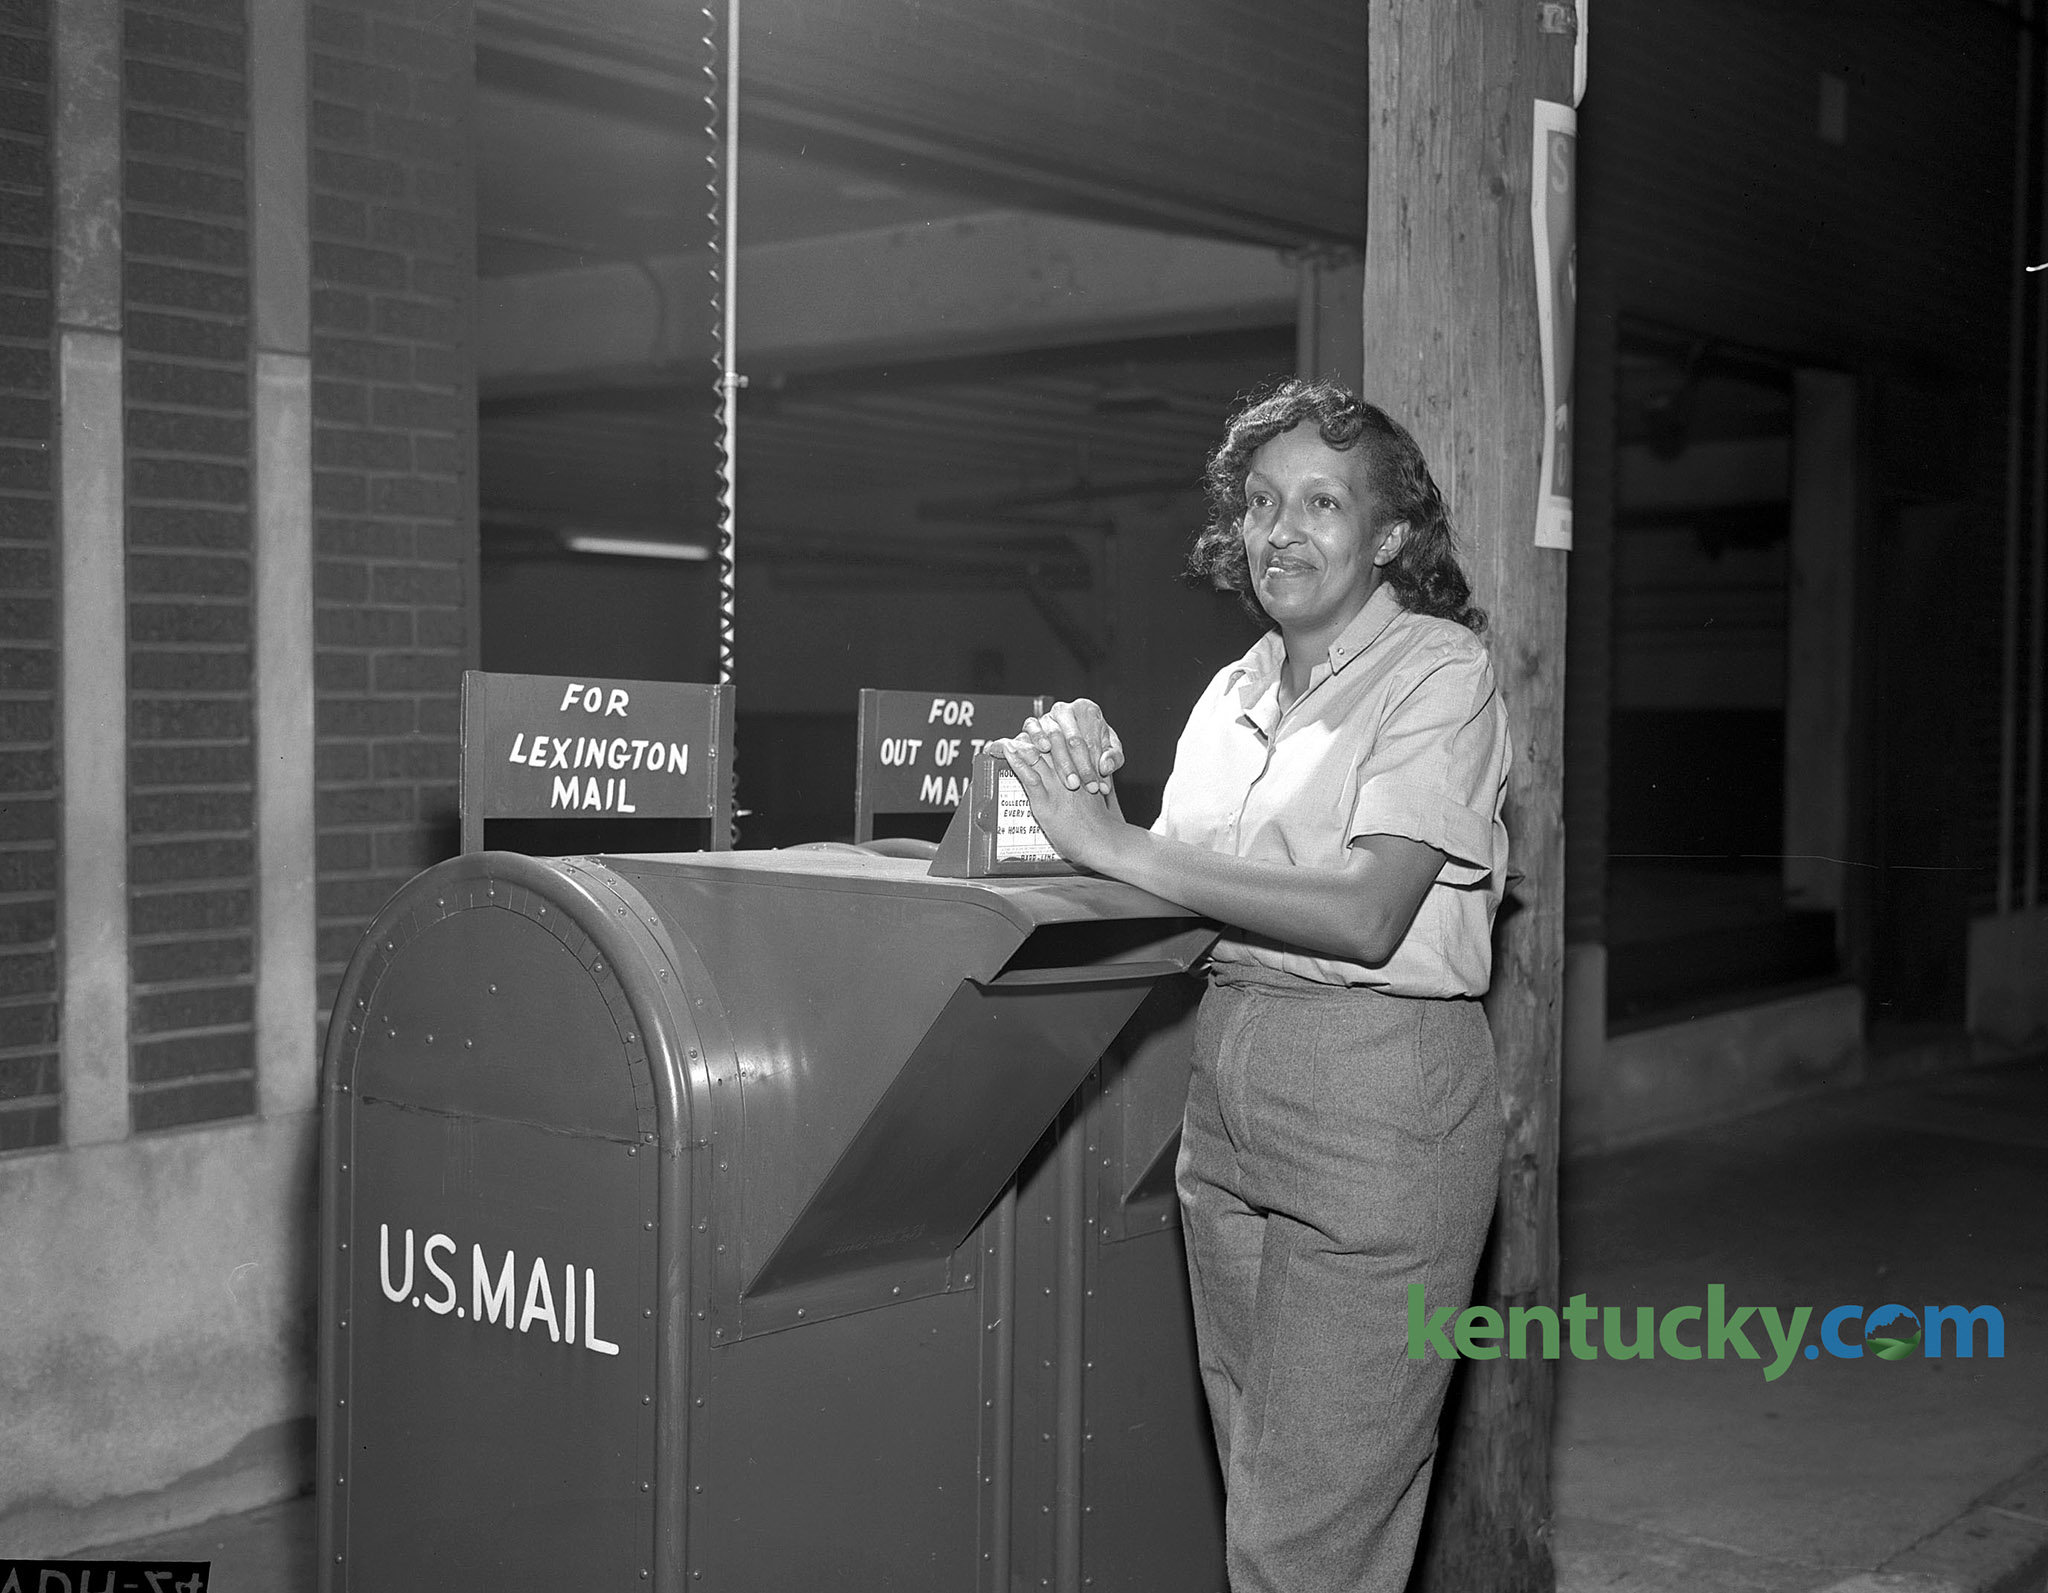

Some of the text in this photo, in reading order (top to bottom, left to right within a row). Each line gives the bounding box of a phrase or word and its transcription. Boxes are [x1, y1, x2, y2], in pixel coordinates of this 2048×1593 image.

[560, 683, 630, 717] FOR
[928, 698, 975, 727] FOR
[508, 732, 689, 775] LEXINGTON
[880, 738, 923, 766] OUT
[934, 738, 961, 767] OF
[550, 775, 636, 814] MAIL
[1003, 809, 1026, 818] EVERY
[1008, 825, 1027, 835] HOURS
[1028, 825, 1041, 834] PER
